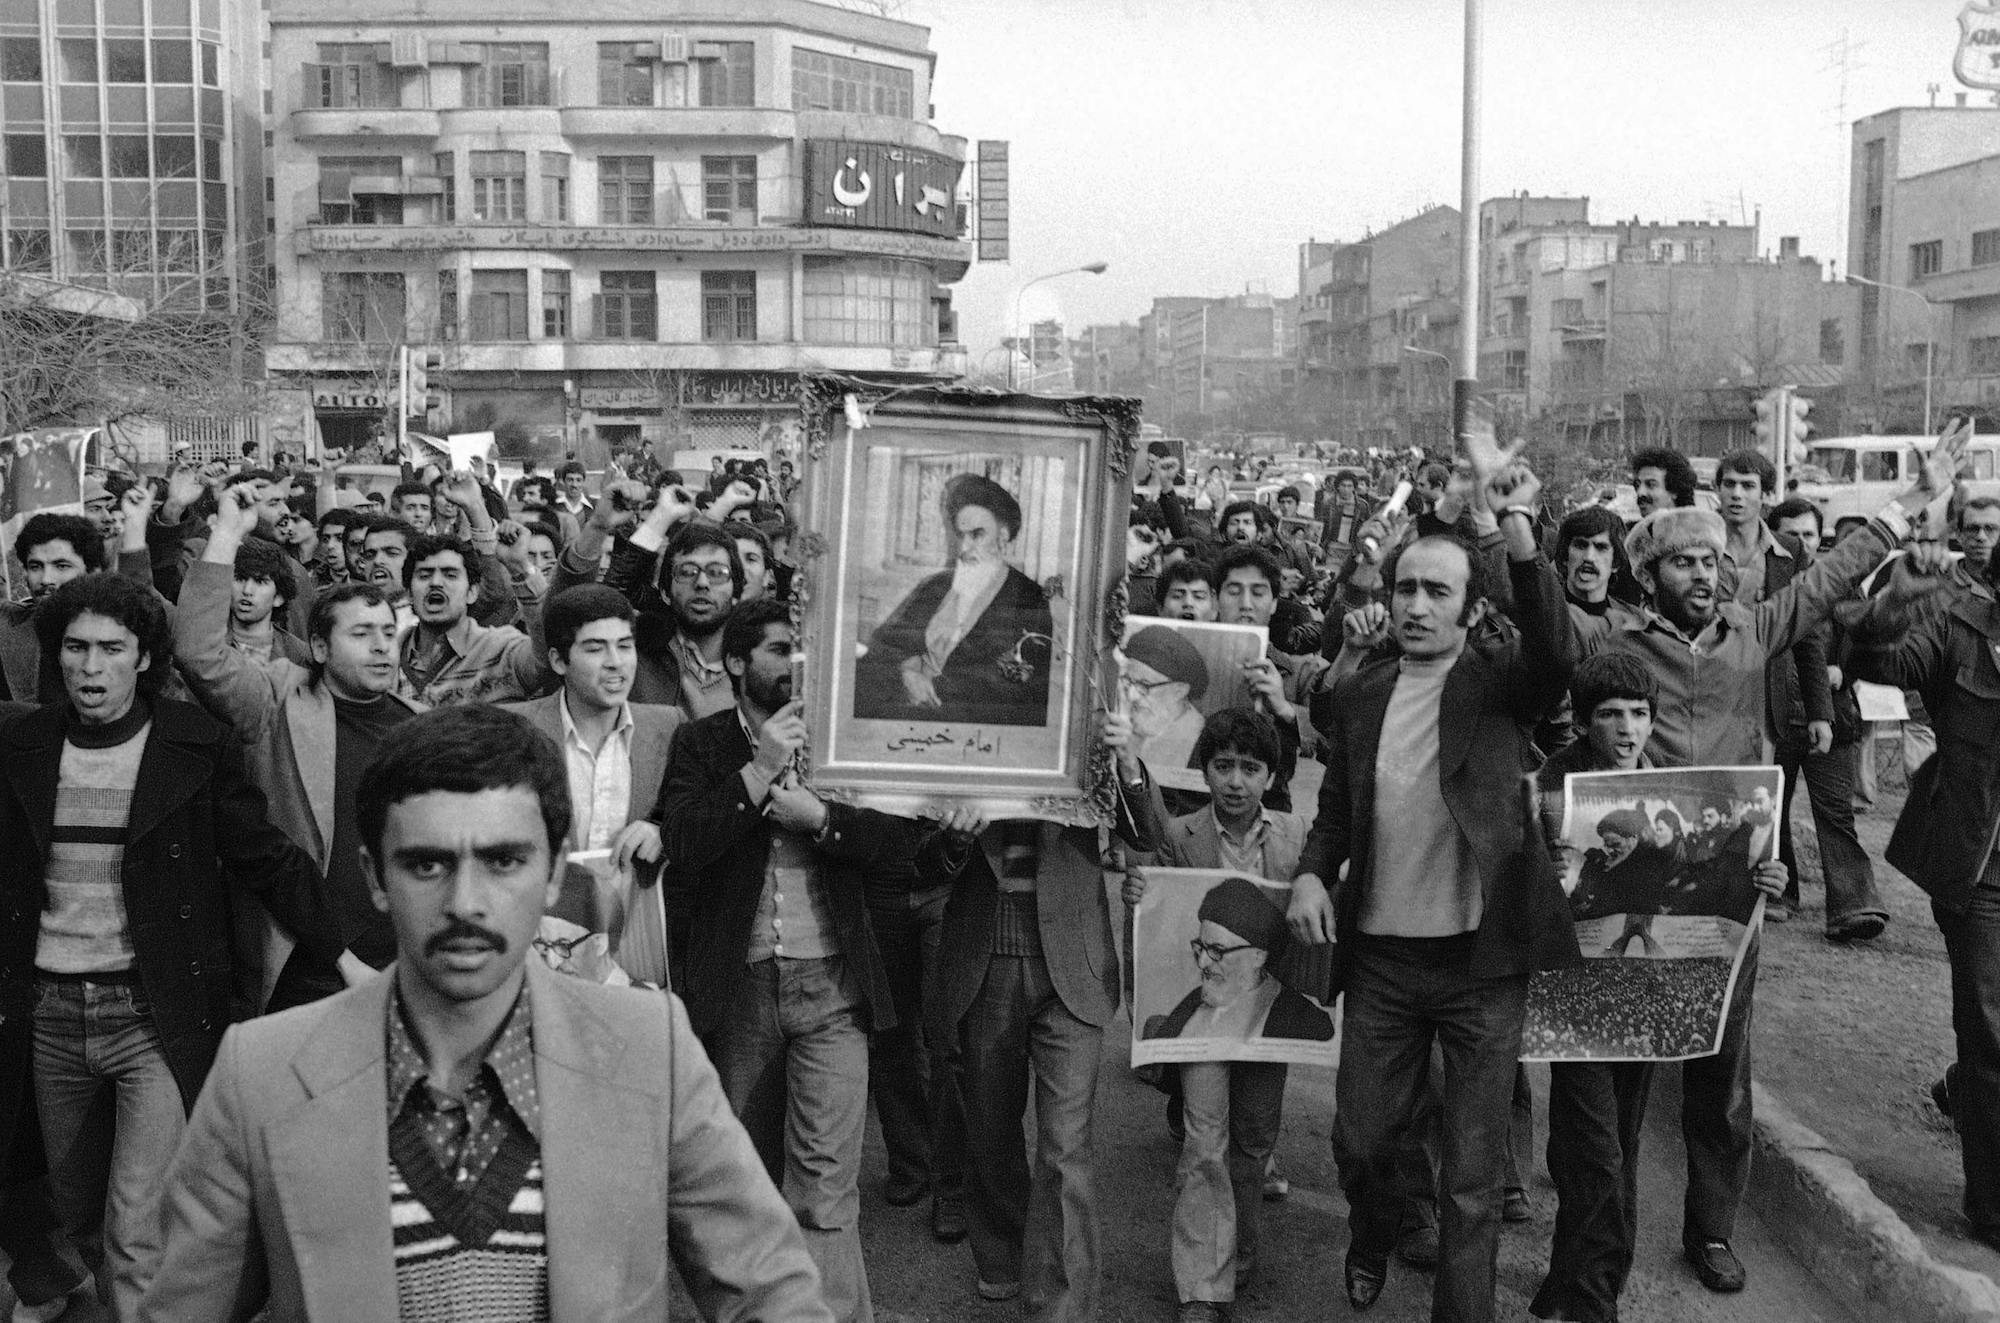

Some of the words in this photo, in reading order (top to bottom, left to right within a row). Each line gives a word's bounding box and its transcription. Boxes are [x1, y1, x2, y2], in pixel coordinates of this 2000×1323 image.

[316, 394, 379, 406] AUTO
[887, 727, 955, 752] خمینی
[962, 729, 1001, 758] امام
